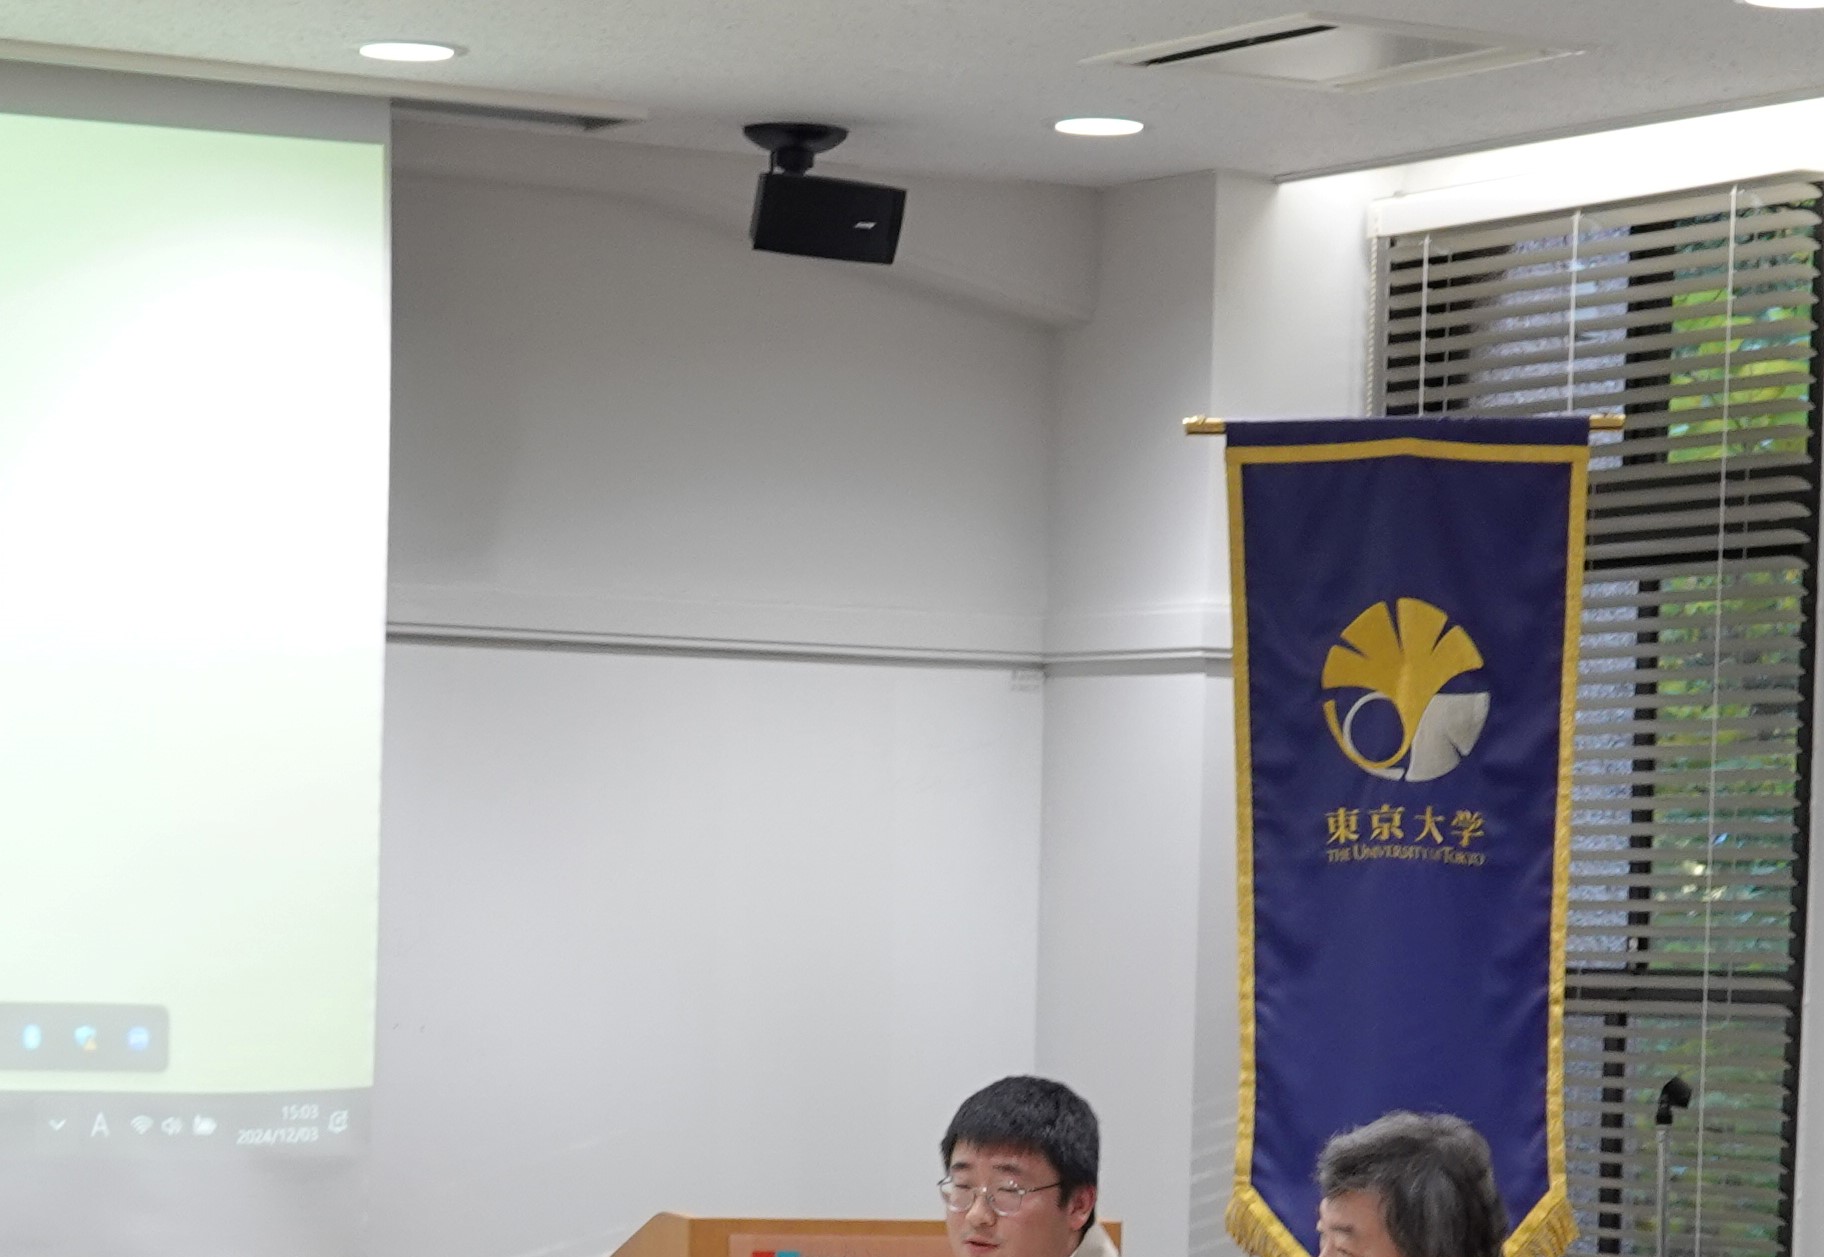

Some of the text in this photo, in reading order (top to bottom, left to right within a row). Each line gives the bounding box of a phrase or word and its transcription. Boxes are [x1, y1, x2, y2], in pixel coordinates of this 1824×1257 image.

[1325, 804, 1486, 847] 東京大学
[236, 1126, 320, 1145] 2024/12/03
